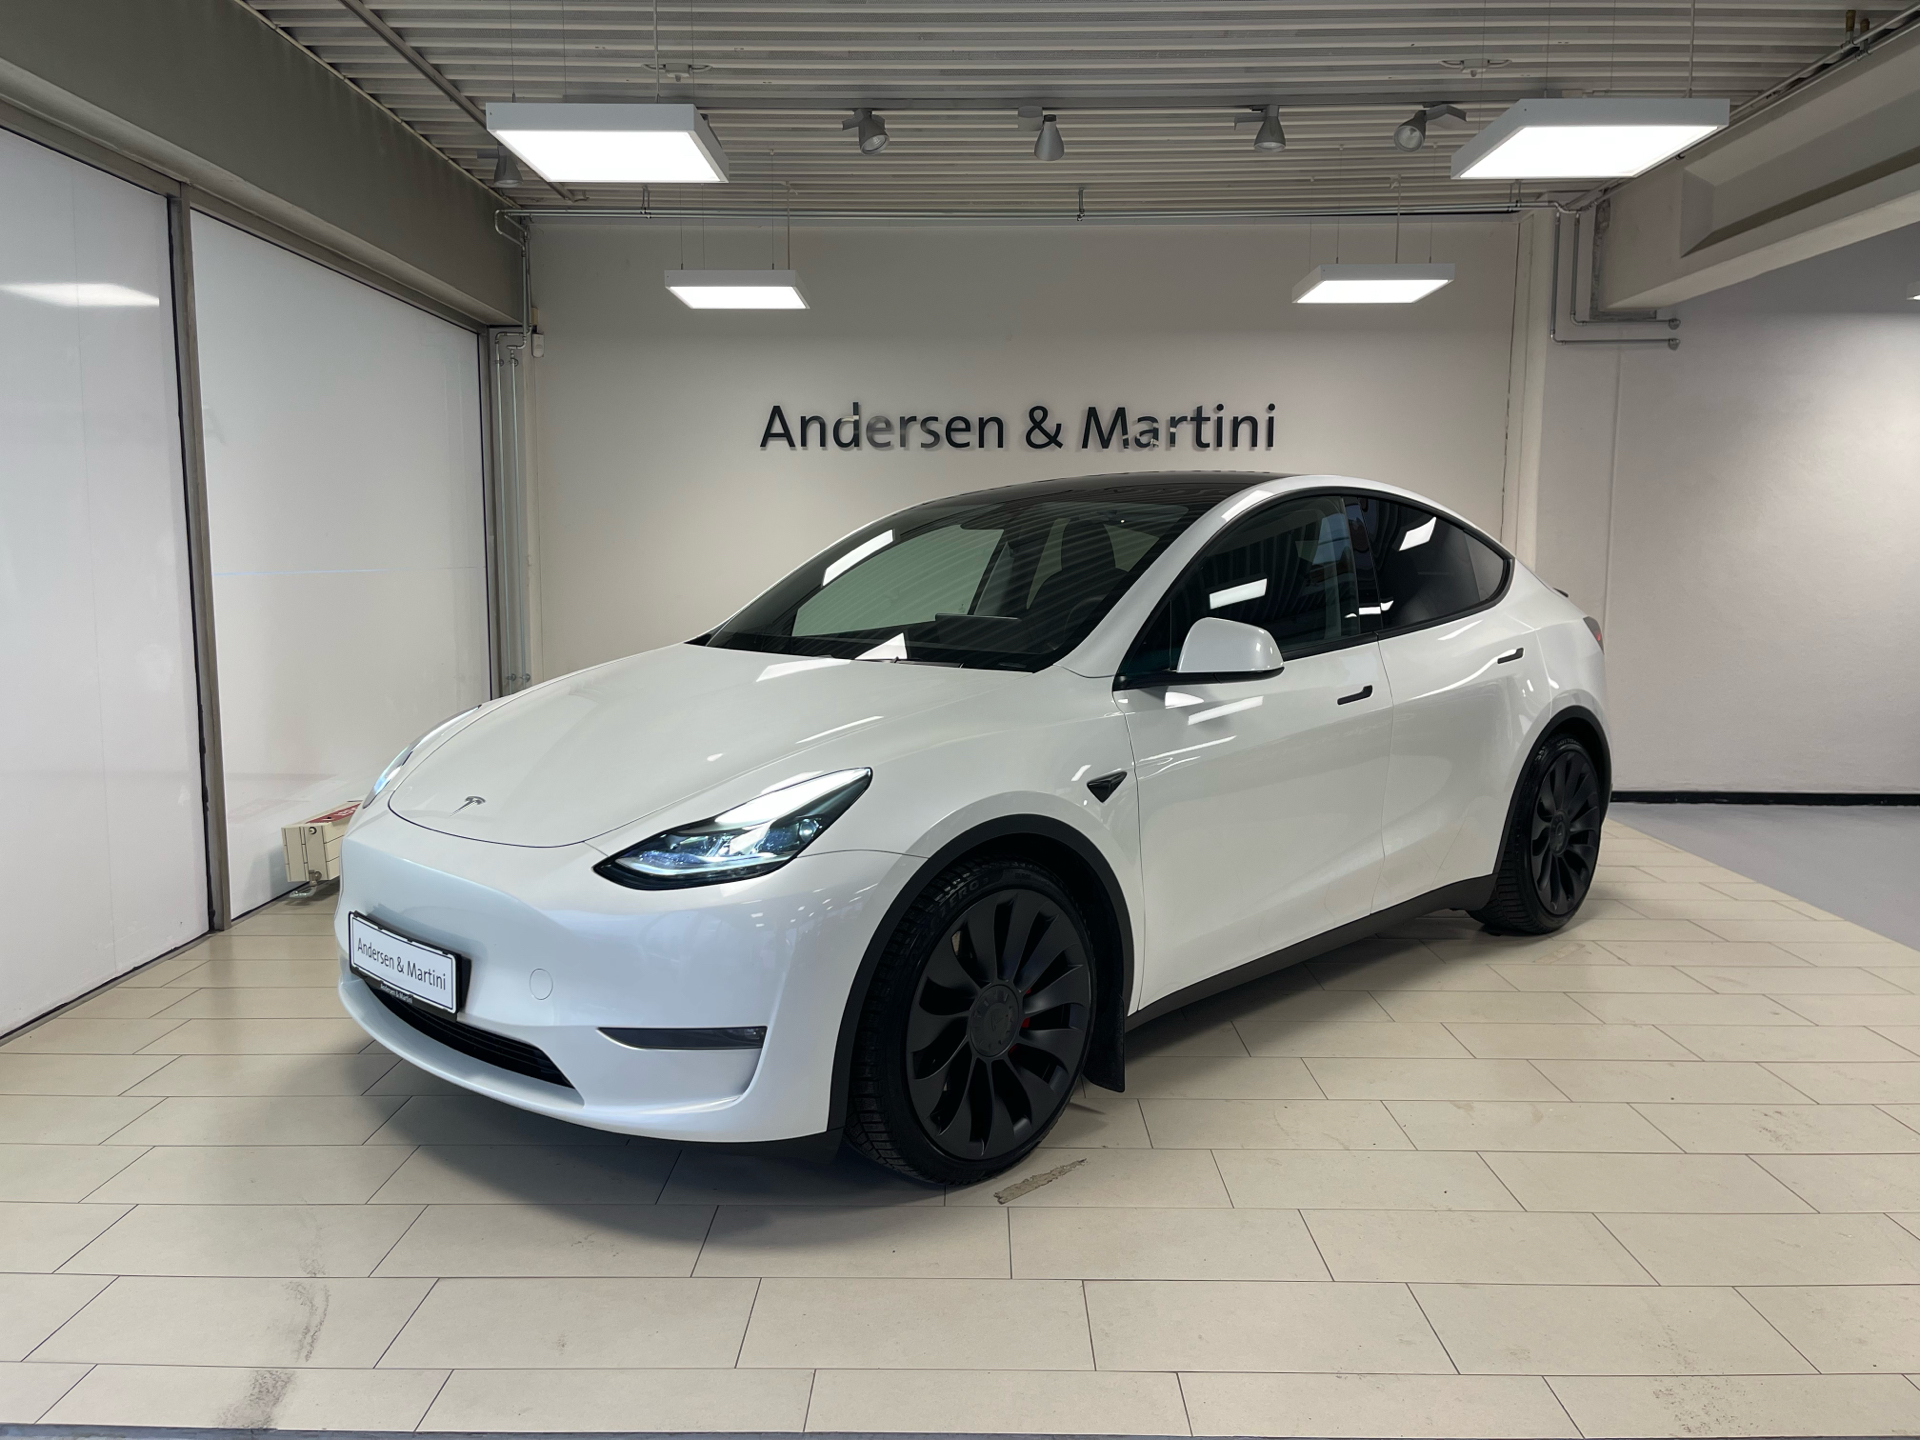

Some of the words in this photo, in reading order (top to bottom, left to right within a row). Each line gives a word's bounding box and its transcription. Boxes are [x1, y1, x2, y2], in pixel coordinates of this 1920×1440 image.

[760, 402, 1004, 449] Andersen
[1025, 405, 1064, 449] &
[1081, 403, 1276, 449] Martini
[357, 937, 395, 970] Andersen
[396, 956, 404, 974] &
[407, 960, 446, 990] Martini
